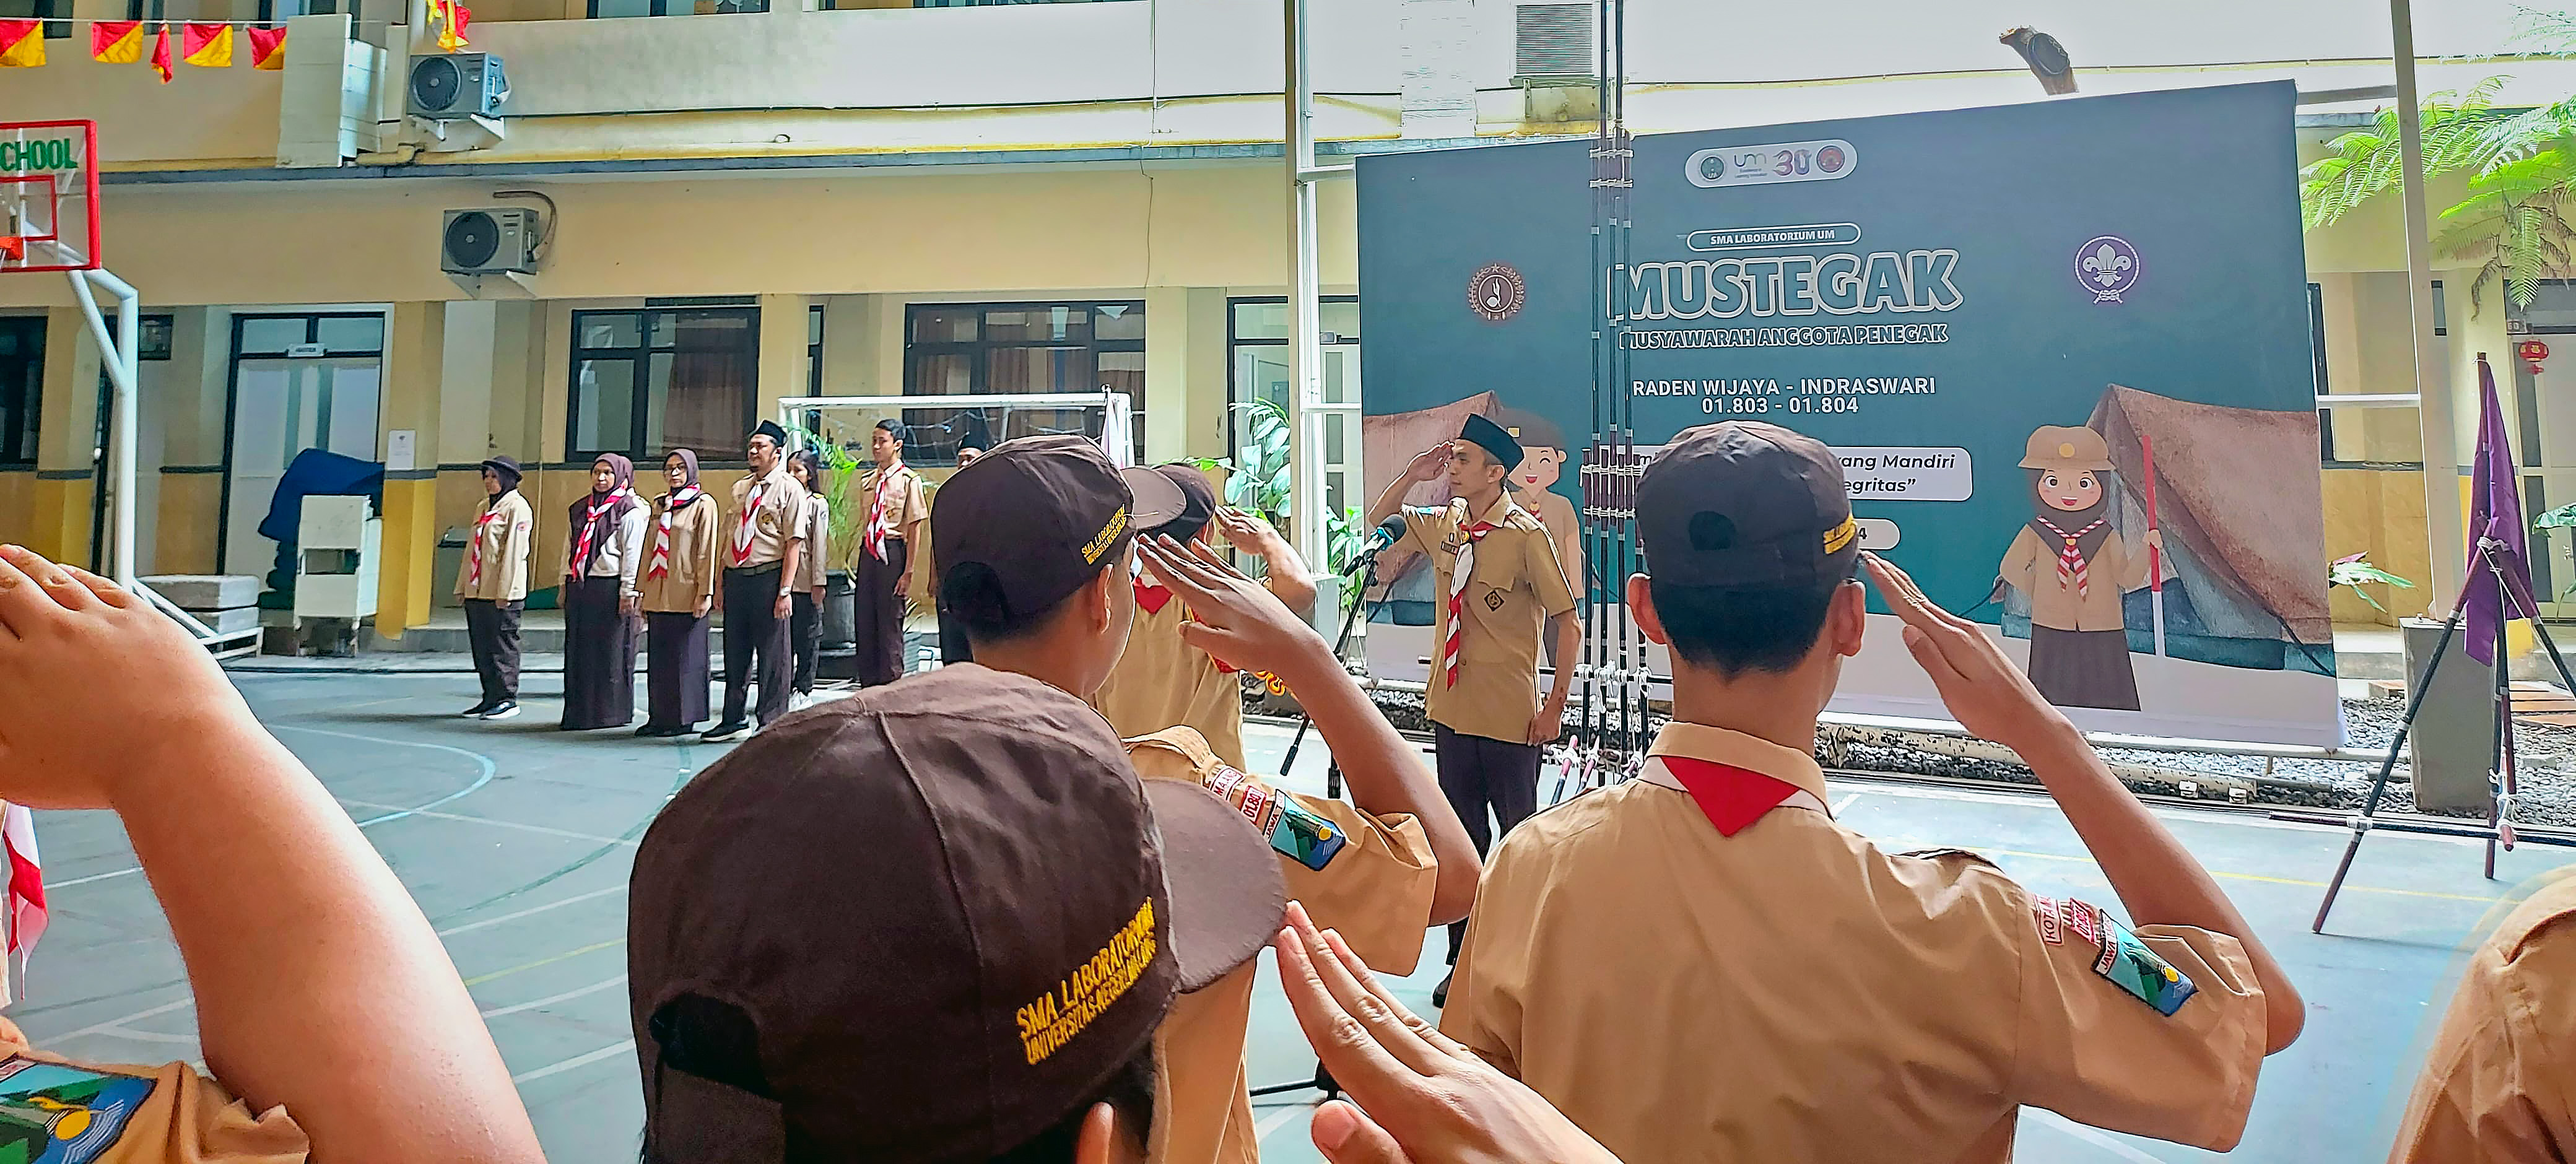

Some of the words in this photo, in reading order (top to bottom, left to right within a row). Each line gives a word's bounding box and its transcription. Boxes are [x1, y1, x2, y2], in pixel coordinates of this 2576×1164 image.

[0, 138, 78, 171] CHOOL
[1710, 235, 1733, 245] SMA
[1735, 231, 1816, 243] LABORATORIUM
[1817, 230, 1835, 240] UM
[1606, 249, 1965, 321] MUSTEGAK
[1757, 325, 1854, 347] ANGGOTA
[1855, 323, 1949, 344] PENEGAK
[1633, 380, 1696, 396] RADEN
[1702, 378, 1780, 396] WIJAYA
[1800, 376, 1936, 395] INDRASWARI
[1701, 396, 1769, 414] 01.803
[1788, 396, 1859, 414] 01.804
[1838, 456, 1877, 471] ang
[1882, 454, 1956, 469] Mandiri
[1843, 477, 1916, 494] egritas”
[2100, 940, 2116, 970] JAWA
[1016, 991, 1059, 1041] SMA
[1022, 994, 1098, 1066] UNIVERSITAS
